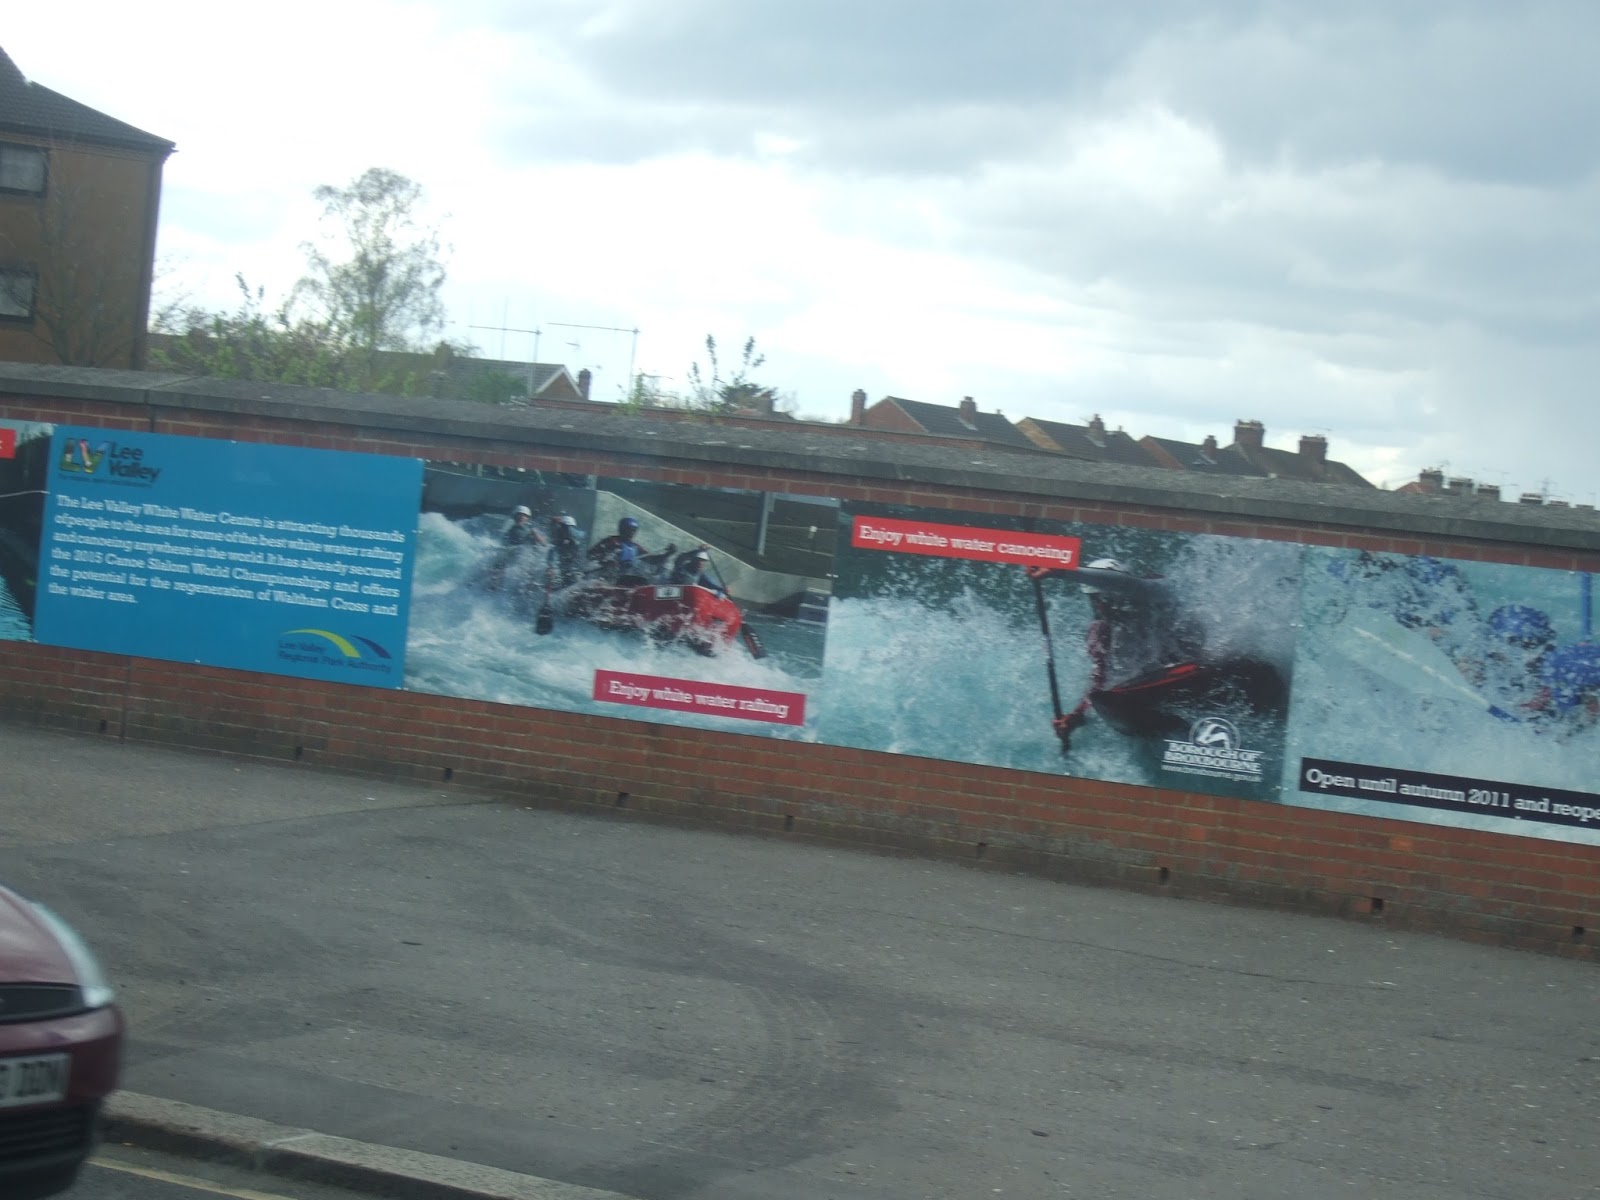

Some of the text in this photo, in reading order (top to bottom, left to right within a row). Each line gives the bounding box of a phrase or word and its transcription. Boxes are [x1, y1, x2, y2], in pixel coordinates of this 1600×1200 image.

[109, 459, 162, 482] Valley
[110, 441, 144, 461] Lee
[54, 513, 405, 564] of people to the area for some of the best white water rafting
[56, 494, 406, 543] The Lee Valley White Water Centre is attracting thousands
[52, 531, 77, 544] and
[77, 535, 133, 553] canoeing
[134, 540, 193, 556] anywhere
[193, 544, 206, 557] in
[206, 546, 227, 560] the
[277, 554, 300, 568] has
[300, 557, 348, 576] already
[348, 564, 402, 580] secured
[859, 524, 1073, 564] Enjoy white water canoeing
[48, 581, 69, 596] the
[69, 585, 106, 600] wider
[49, 564, 399, 617] the potential for the regeneration of Waltham Cross and
[51, 546, 72, 560] the
[105, 553, 146, 569] Canoe
[147, 557, 191, 574] Slalom
[191, 562, 231, 578] World
[232, 567, 332, 592] Championships
[333, 580, 360, 594] and
[361, 583, 400, 598] offers
[609, 680, 790, 718] Enjoy white water rafting
[1306, 768, 1356, 789] Open
[1358, 777, 1398, 794] until
[1399, 783, 1466, 802] autumn
[1468, 788, 1511, 808] 2011
[1514, 798, 1550, 814] and
